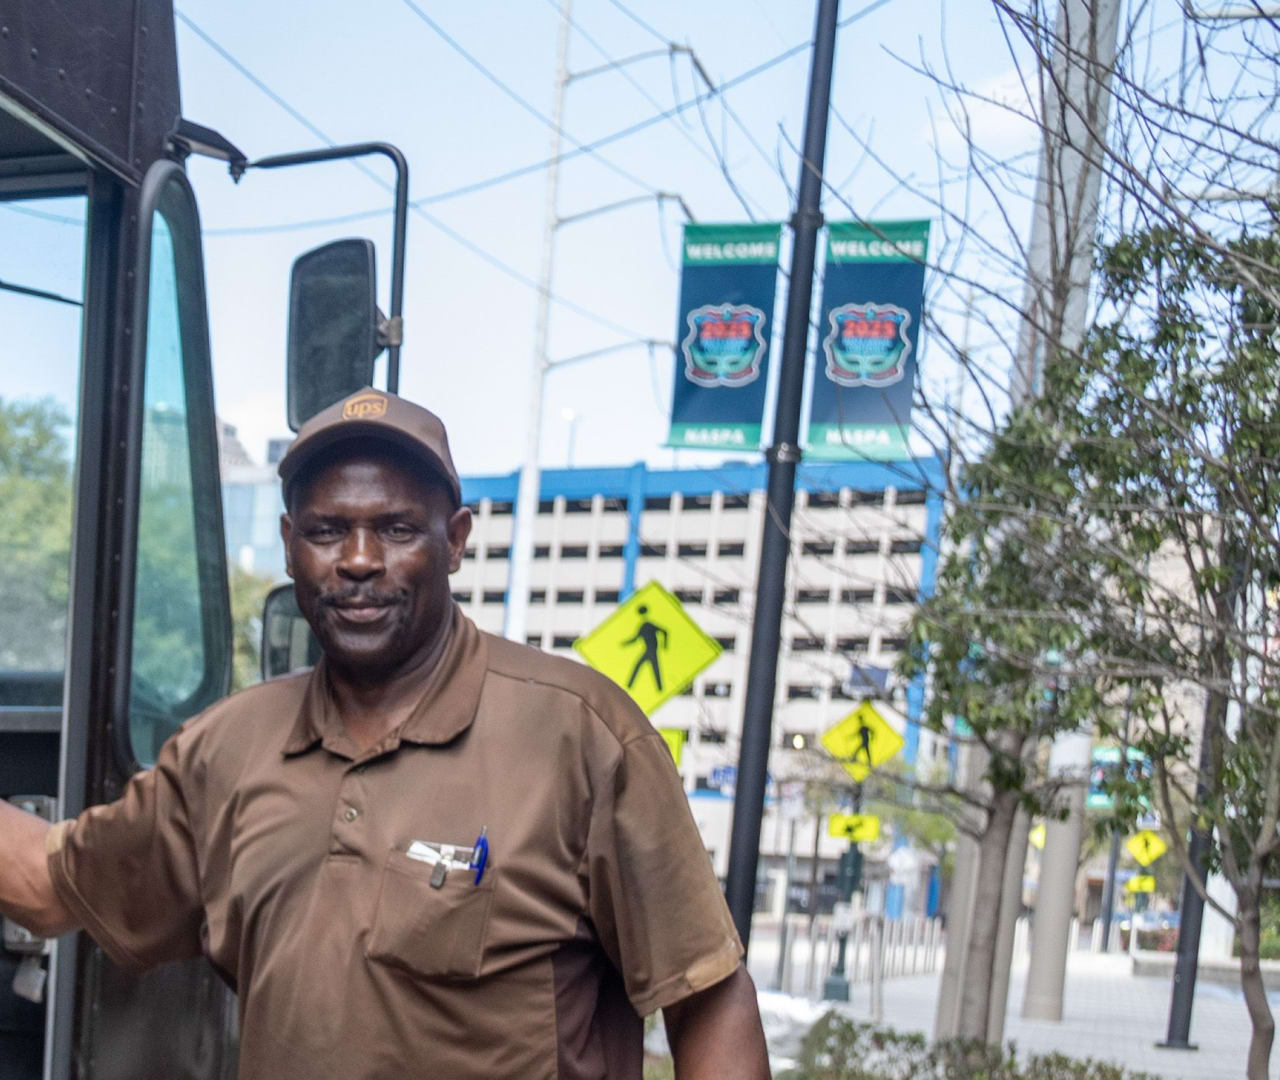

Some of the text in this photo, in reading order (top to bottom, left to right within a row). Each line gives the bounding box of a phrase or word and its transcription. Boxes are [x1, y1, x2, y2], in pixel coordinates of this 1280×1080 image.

[687, 242, 776, 259] WELCOME
[831, 240, 923, 257] WELCOME
[346, 401, 383, 418] ups
[684, 428, 745, 444] NASPA
[826, 428, 890, 444] NASPA
